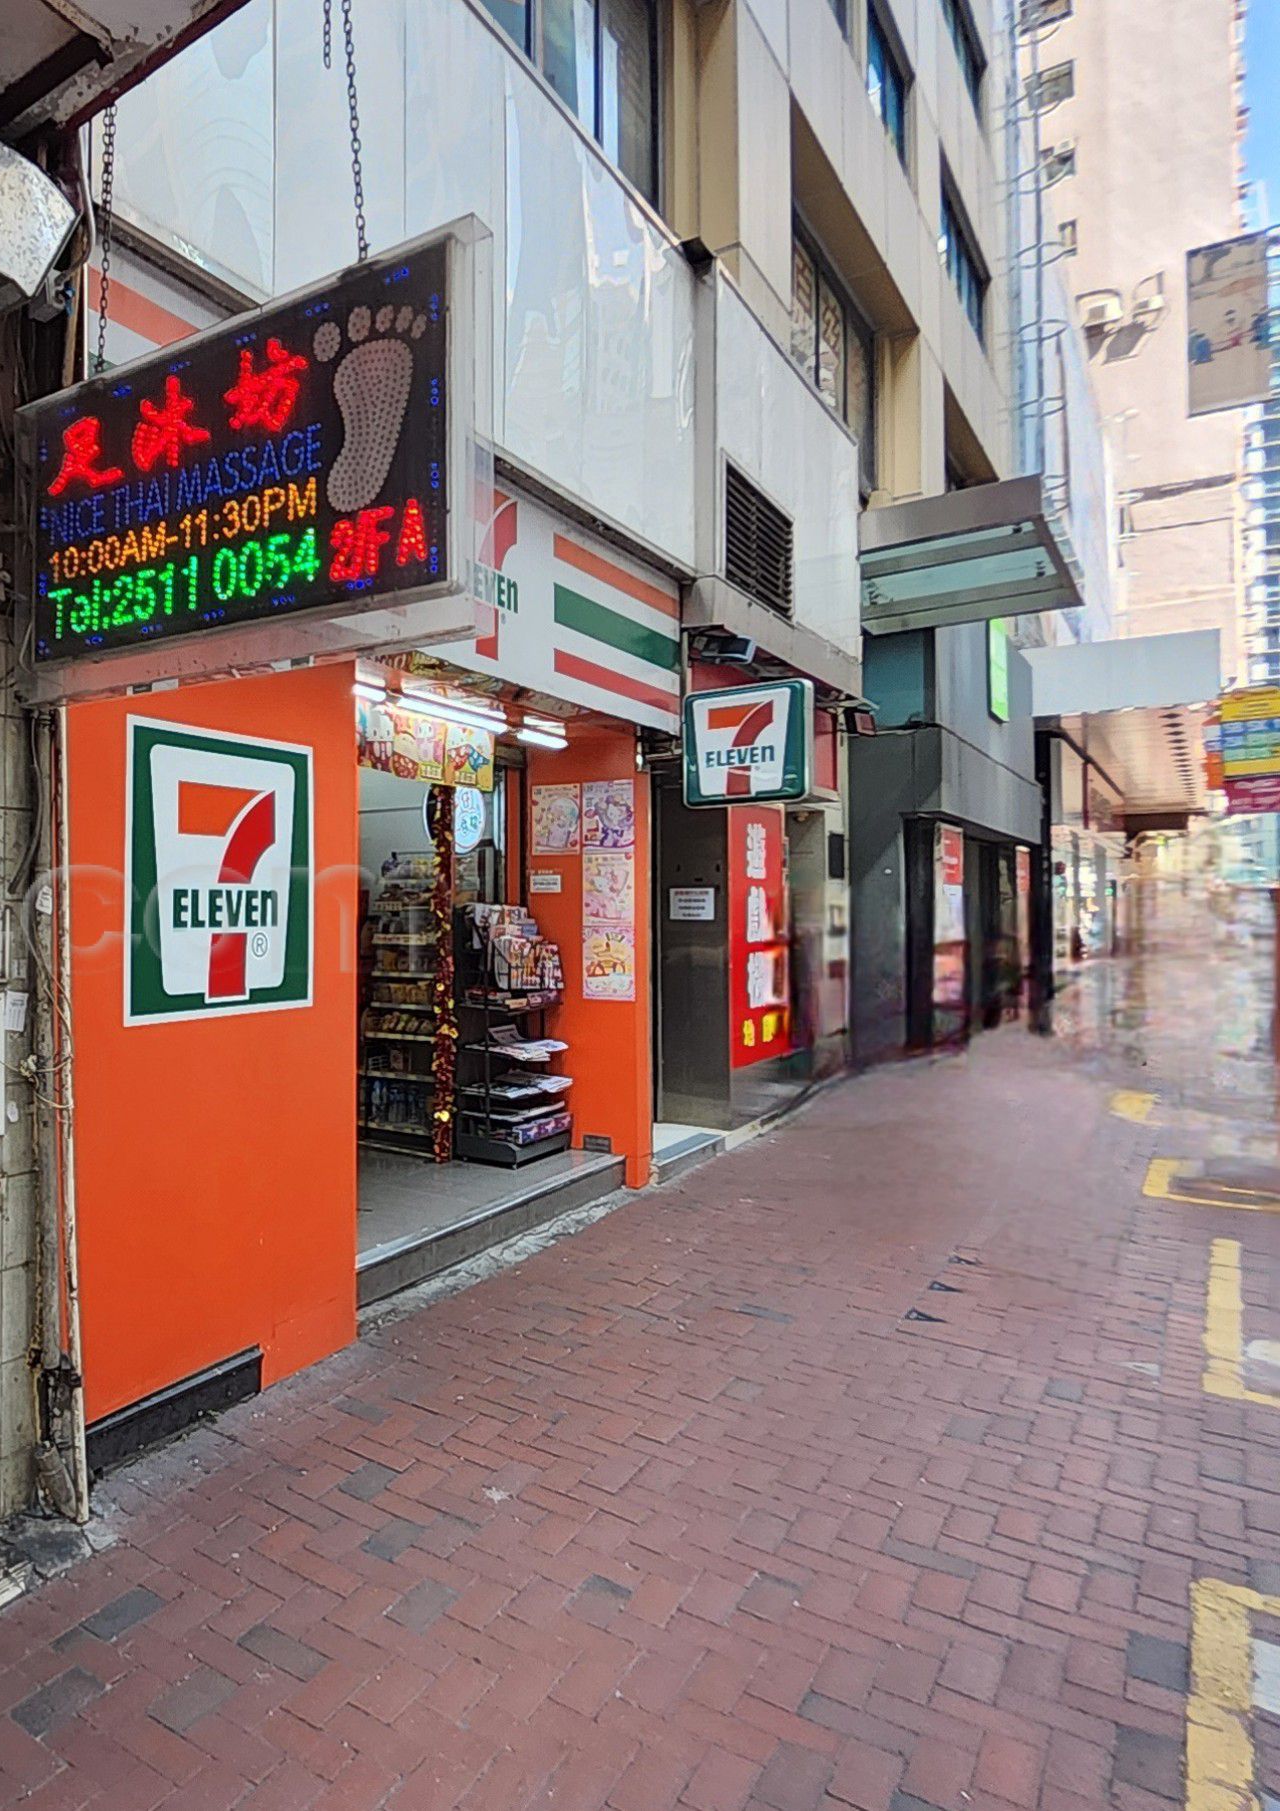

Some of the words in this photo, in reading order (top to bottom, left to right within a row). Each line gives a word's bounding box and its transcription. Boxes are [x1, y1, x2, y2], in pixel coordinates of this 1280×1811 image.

[47, 337, 309, 496] 足沐坊
[48, 476, 318, 584] 10:00AM-11:30PM
[49, 493, 106, 546] NICE
[110, 472, 170, 529] THAI
[176, 422, 323, 511] MASSAGE
[395, 498, 429, 567] A
[212, 527, 322, 601] 0054
[707, 699, 774, 796] 7
[177, 779, 277, 999] 7
